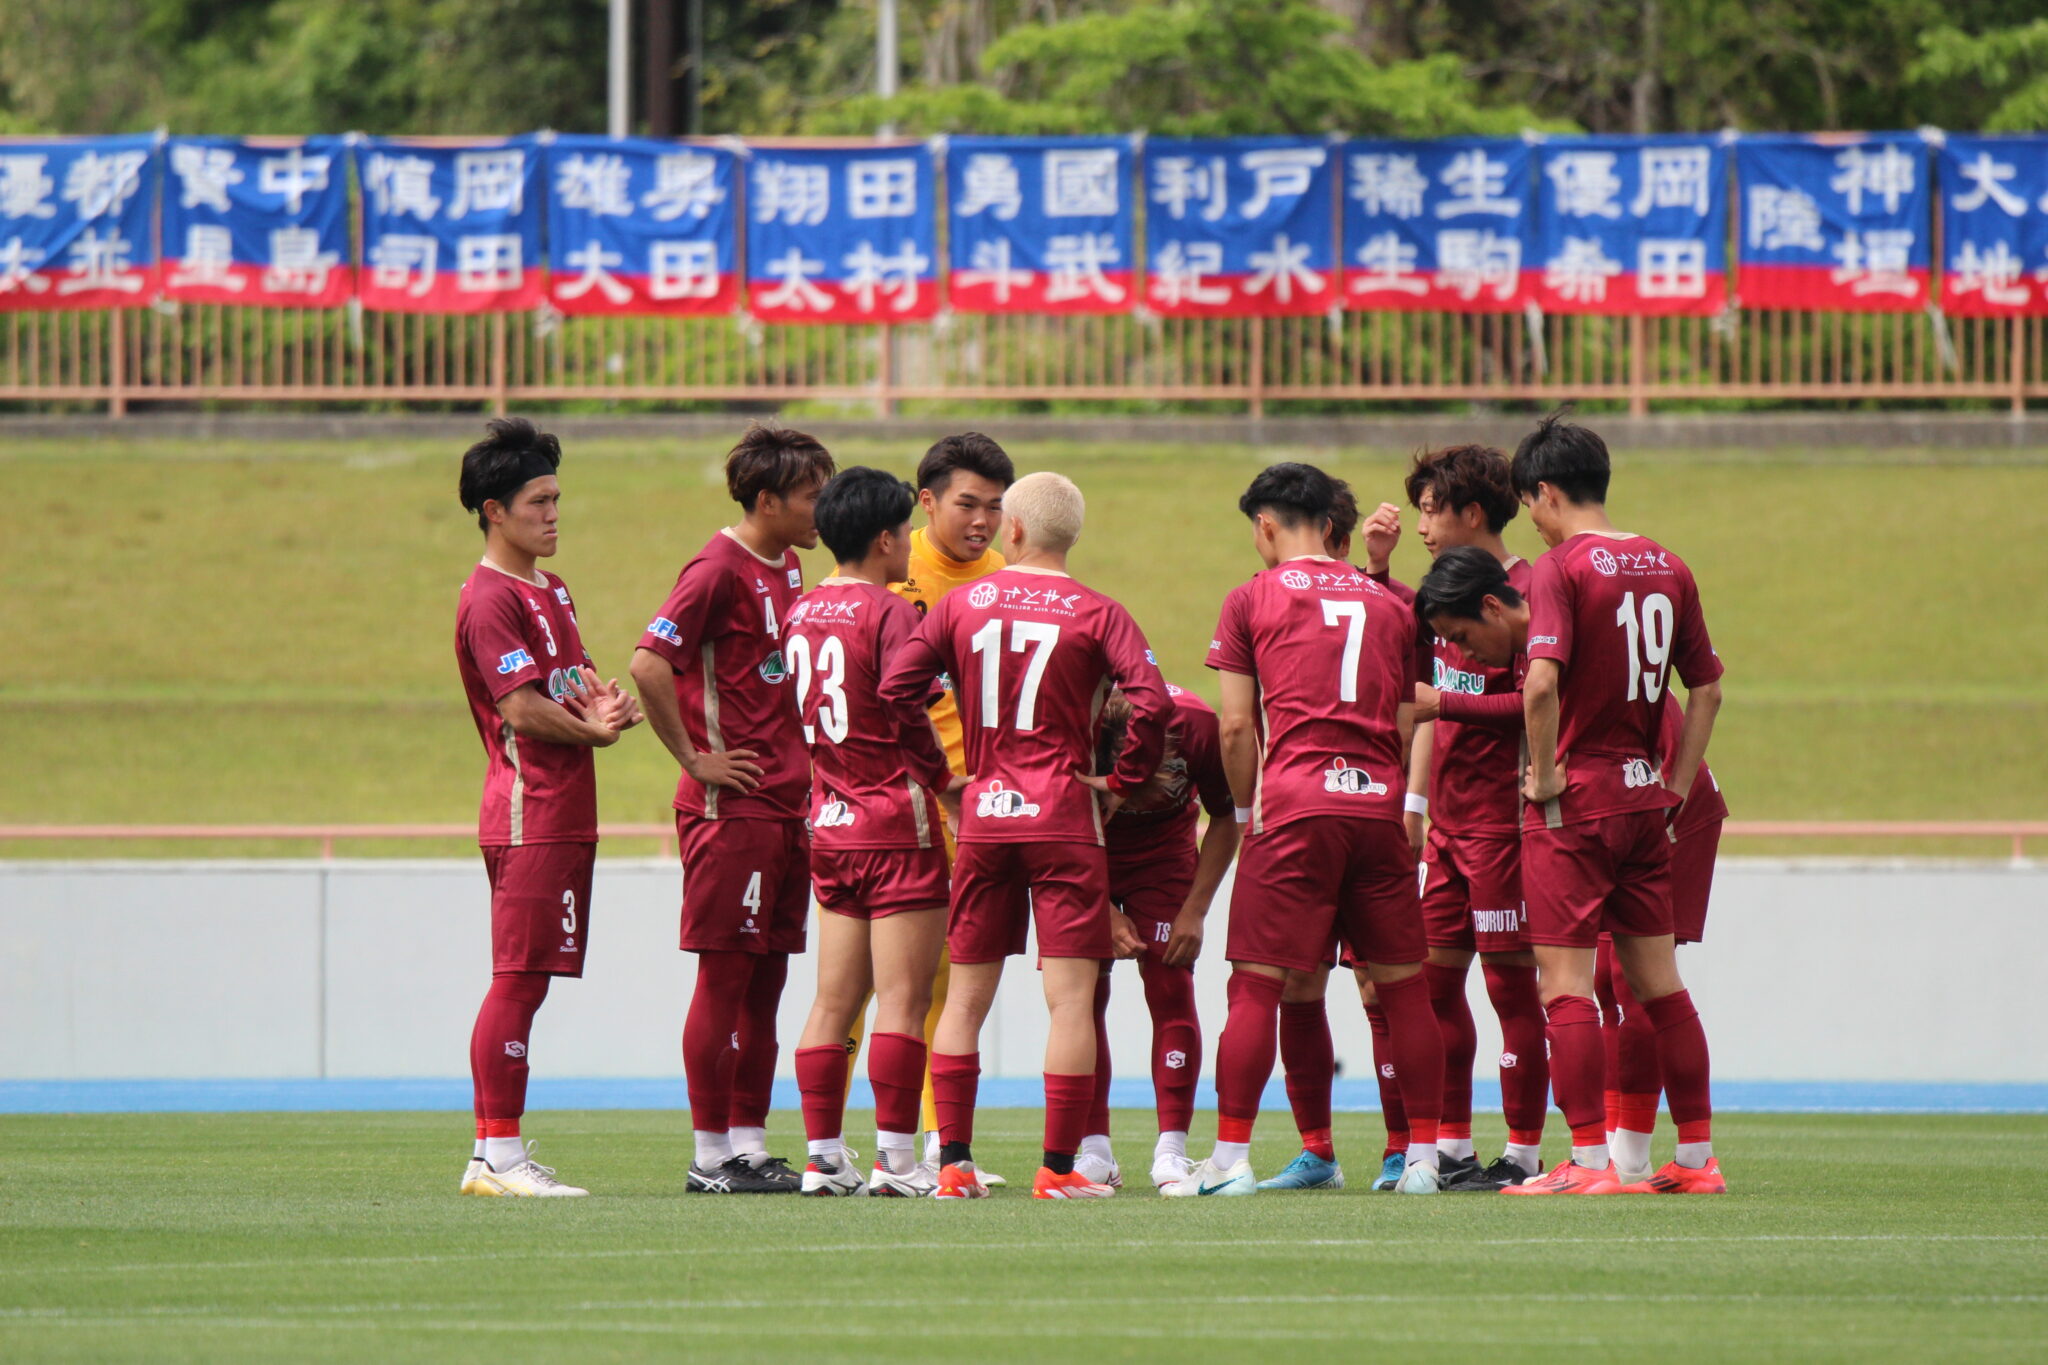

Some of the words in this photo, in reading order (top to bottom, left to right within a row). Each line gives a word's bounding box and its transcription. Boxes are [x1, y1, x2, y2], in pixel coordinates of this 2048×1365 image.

[1950, 152, 2031, 306] 大地
[538, 614, 557, 657] 3
[648, 616, 681, 640] JFL
[764, 596, 779, 640] 4
[497, 648, 535, 675] JFL
[1320, 598, 1367, 703] 7
[1616, 591, 1674, 704] 19
[786, 633, 849, 745] 23
[971, 618, 1061, 731] 17
[562, 889, 577, 934] 3
[742, 871, 762, 915] 4
[1473, 909, 1519, 933] TSURUTA
